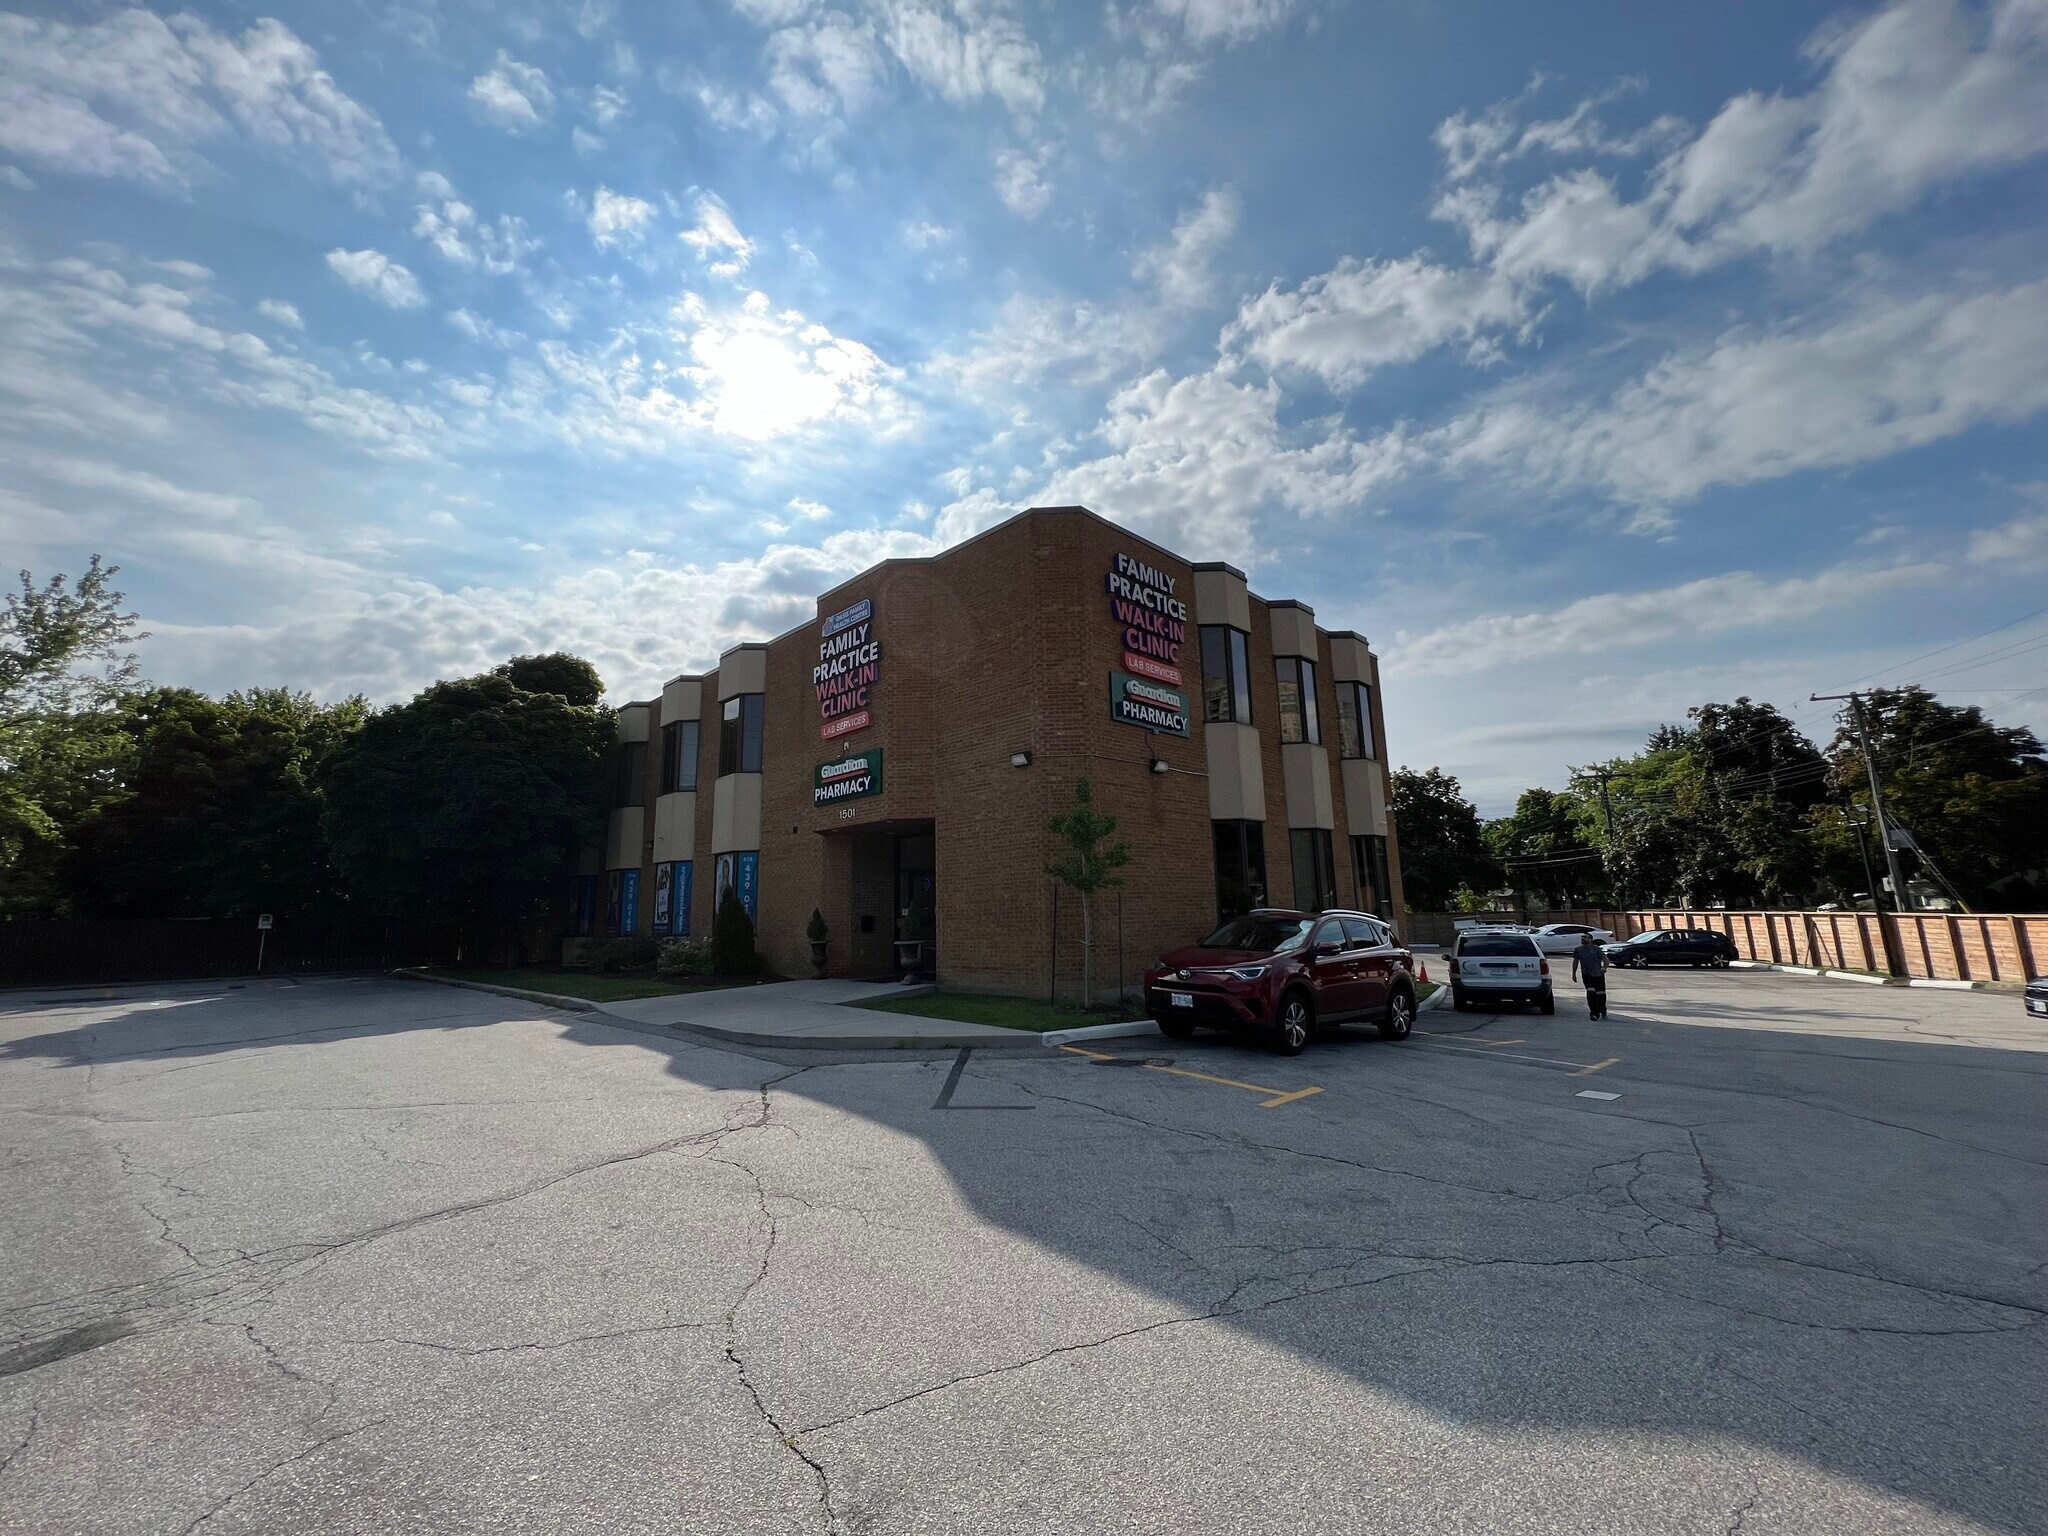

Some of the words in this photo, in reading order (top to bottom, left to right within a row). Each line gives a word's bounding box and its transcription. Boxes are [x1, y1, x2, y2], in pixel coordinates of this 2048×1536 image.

[1118, 552, 1176, 594] FAMILY
[849, 602, 866, 615] FAMILY
[1109, 572, 1187, 621] PRACTICE
[833, 618, 850, 631] HEALTH
[850, 608, 868, 622] CENTRE
[1115, 599, 1185, 643] WALK-IN
[820, 623, 869, 661] FAMILY
[1126, 627, 1179, 663] CLINIC
[813, 641, 879, 685] PRACTICE
[1128, 657, 1144, 670] LAB
[1145, 663, 1179, 681] SERVICES
[816, 662, 875, 701] WALK-IN
[1126, 680, 1180, 707] Guardian
[821, 687, 867, 718] CLINIC
[1122, 700, 1187, 730] PHARMACY
[823, 726, 836, 736] LAB
[836, 714, 866, 732] SERVICES
[821, 758, 869, 779] Guardian
[814, 775, 871, 802] PHARMACY
[839, 808, 856, 820] 1501
